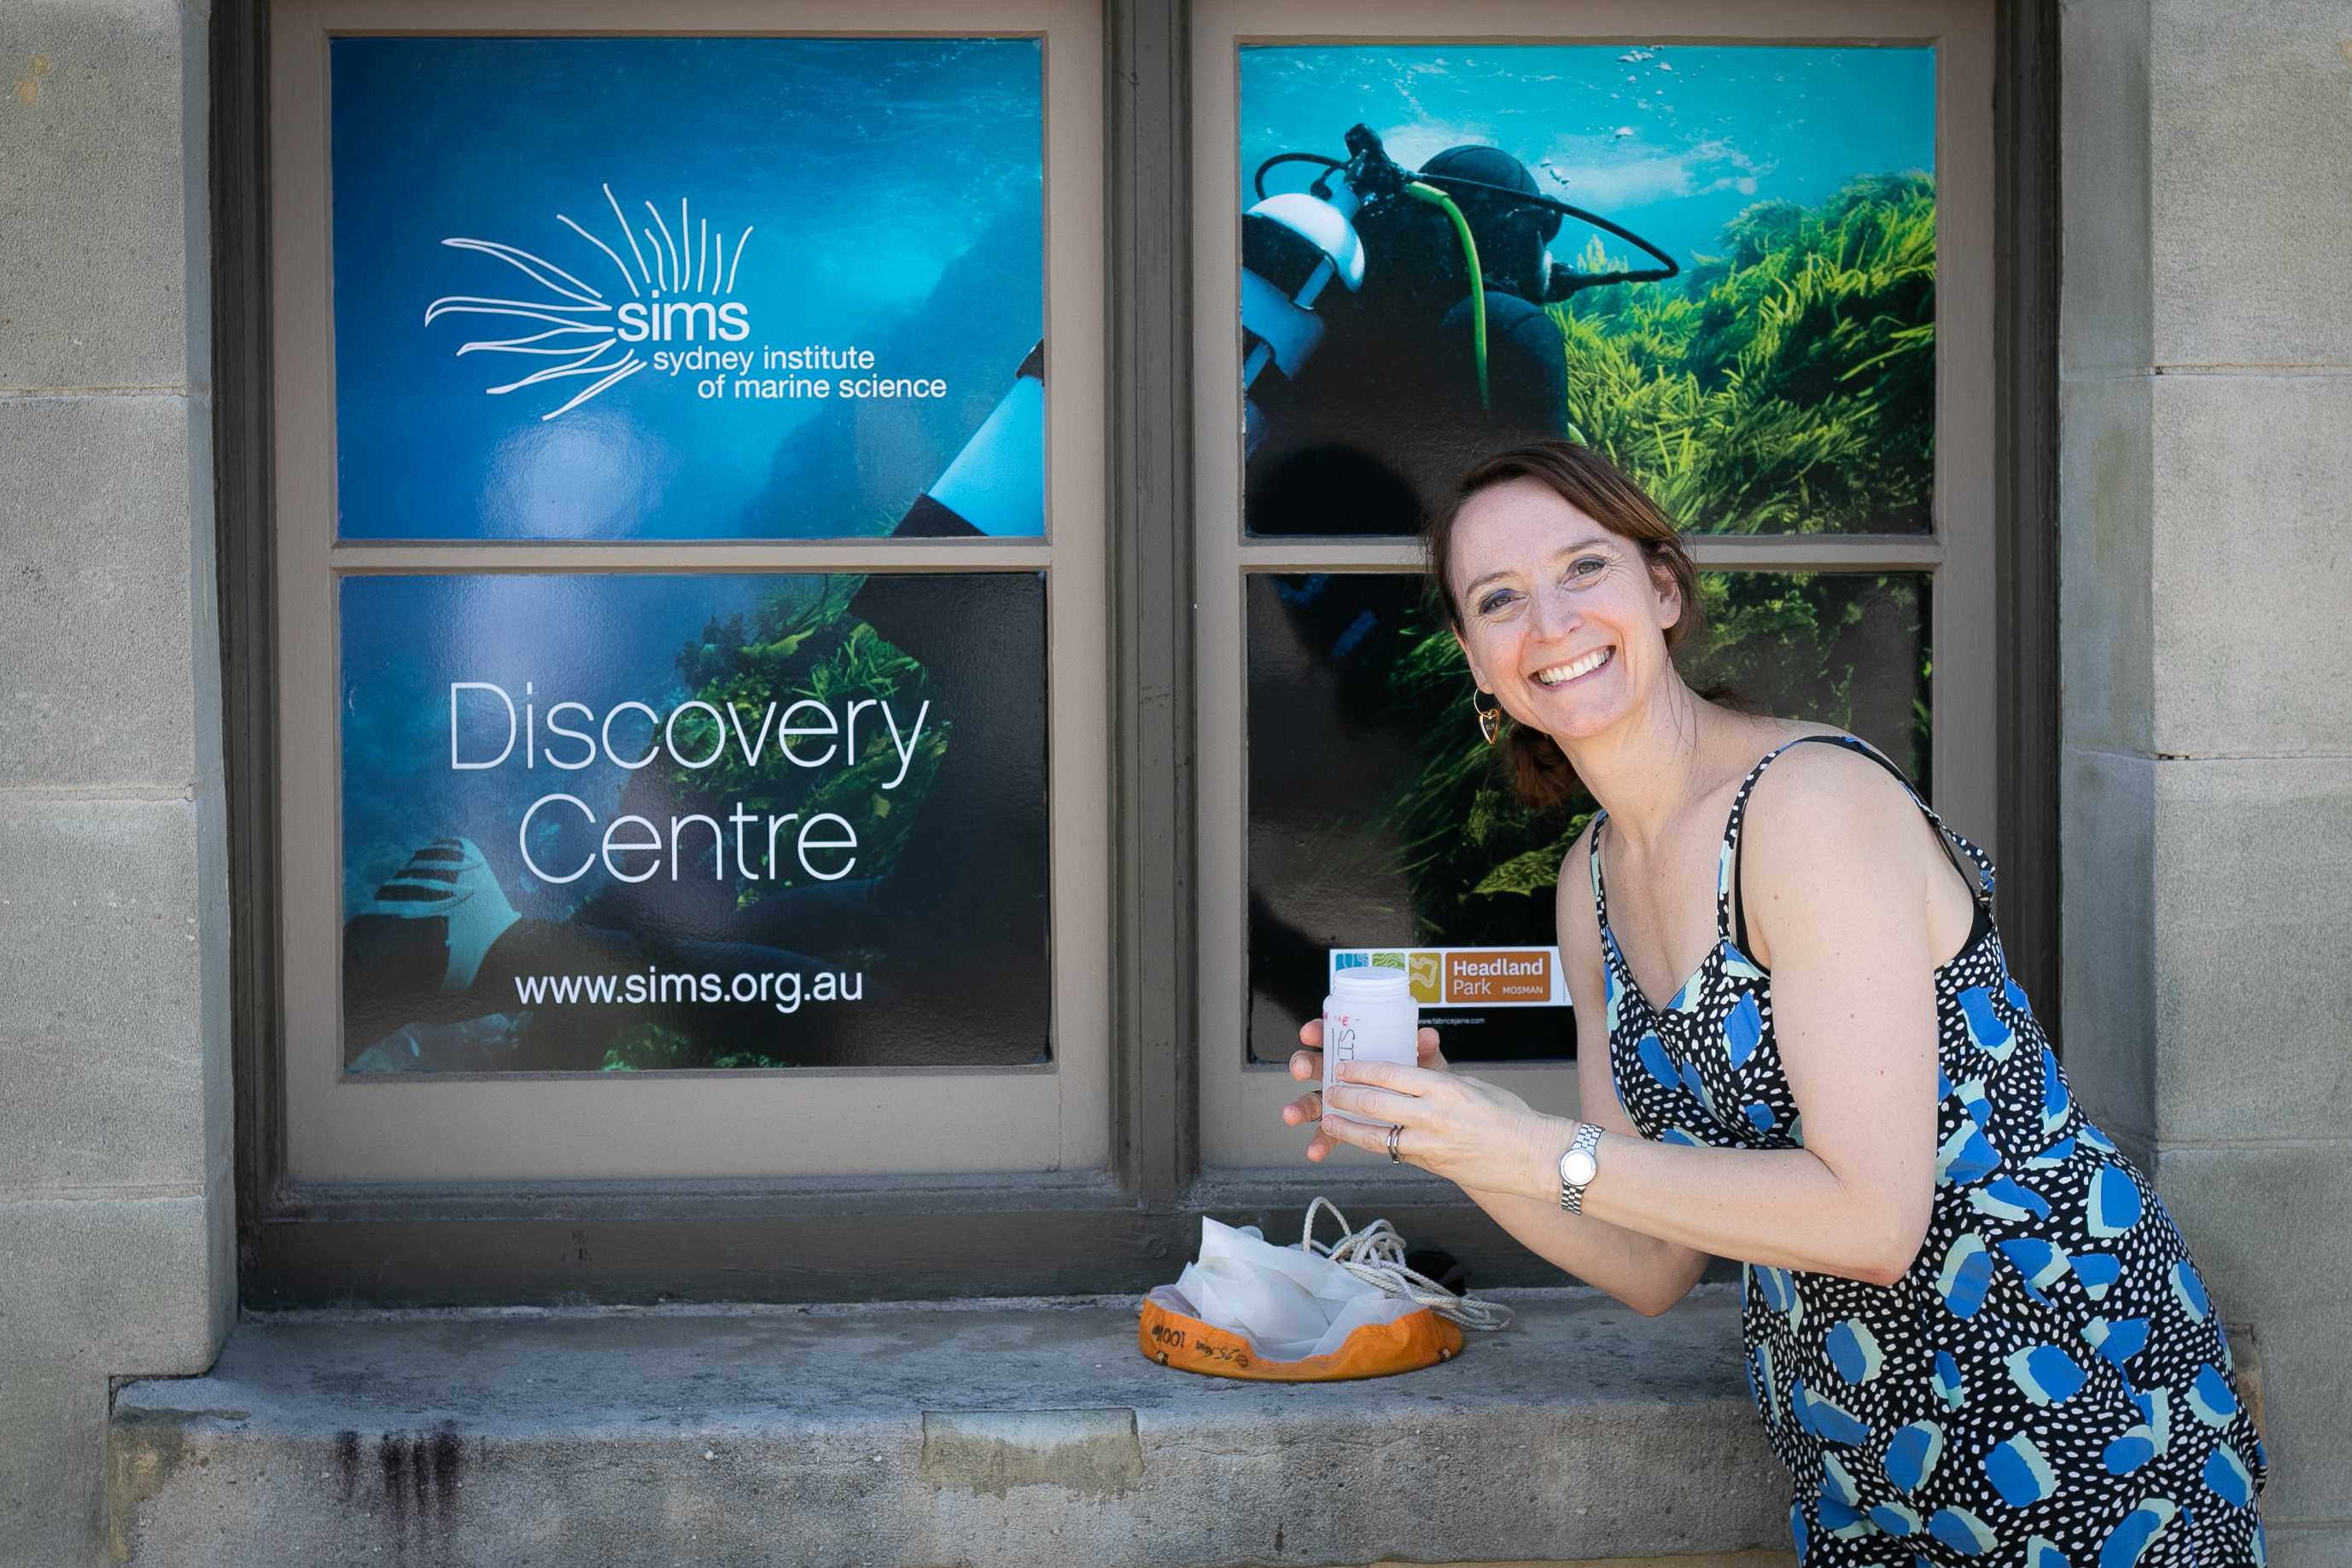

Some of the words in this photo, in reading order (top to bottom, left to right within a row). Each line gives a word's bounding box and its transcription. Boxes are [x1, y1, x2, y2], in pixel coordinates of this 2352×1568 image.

[617, 290, 750, 342] sims
[653, 345, 755, 376] sydney
[764, 344, 875, 370] institute
[697, 373, 724, 399] of
[734, 373, 830, 399] marine
[838, 373, 947, 399] science
[451, 681, 930, 790] Discovery
[519, 793, 858, 883] Centre
[1453, 957, 1544, 976] Headland
[1453, 977, 1491, 995] Park
[1503, 986, 1544, 994] MOSMAN
[514, 965, 863, 1014] www.sims.org.au
